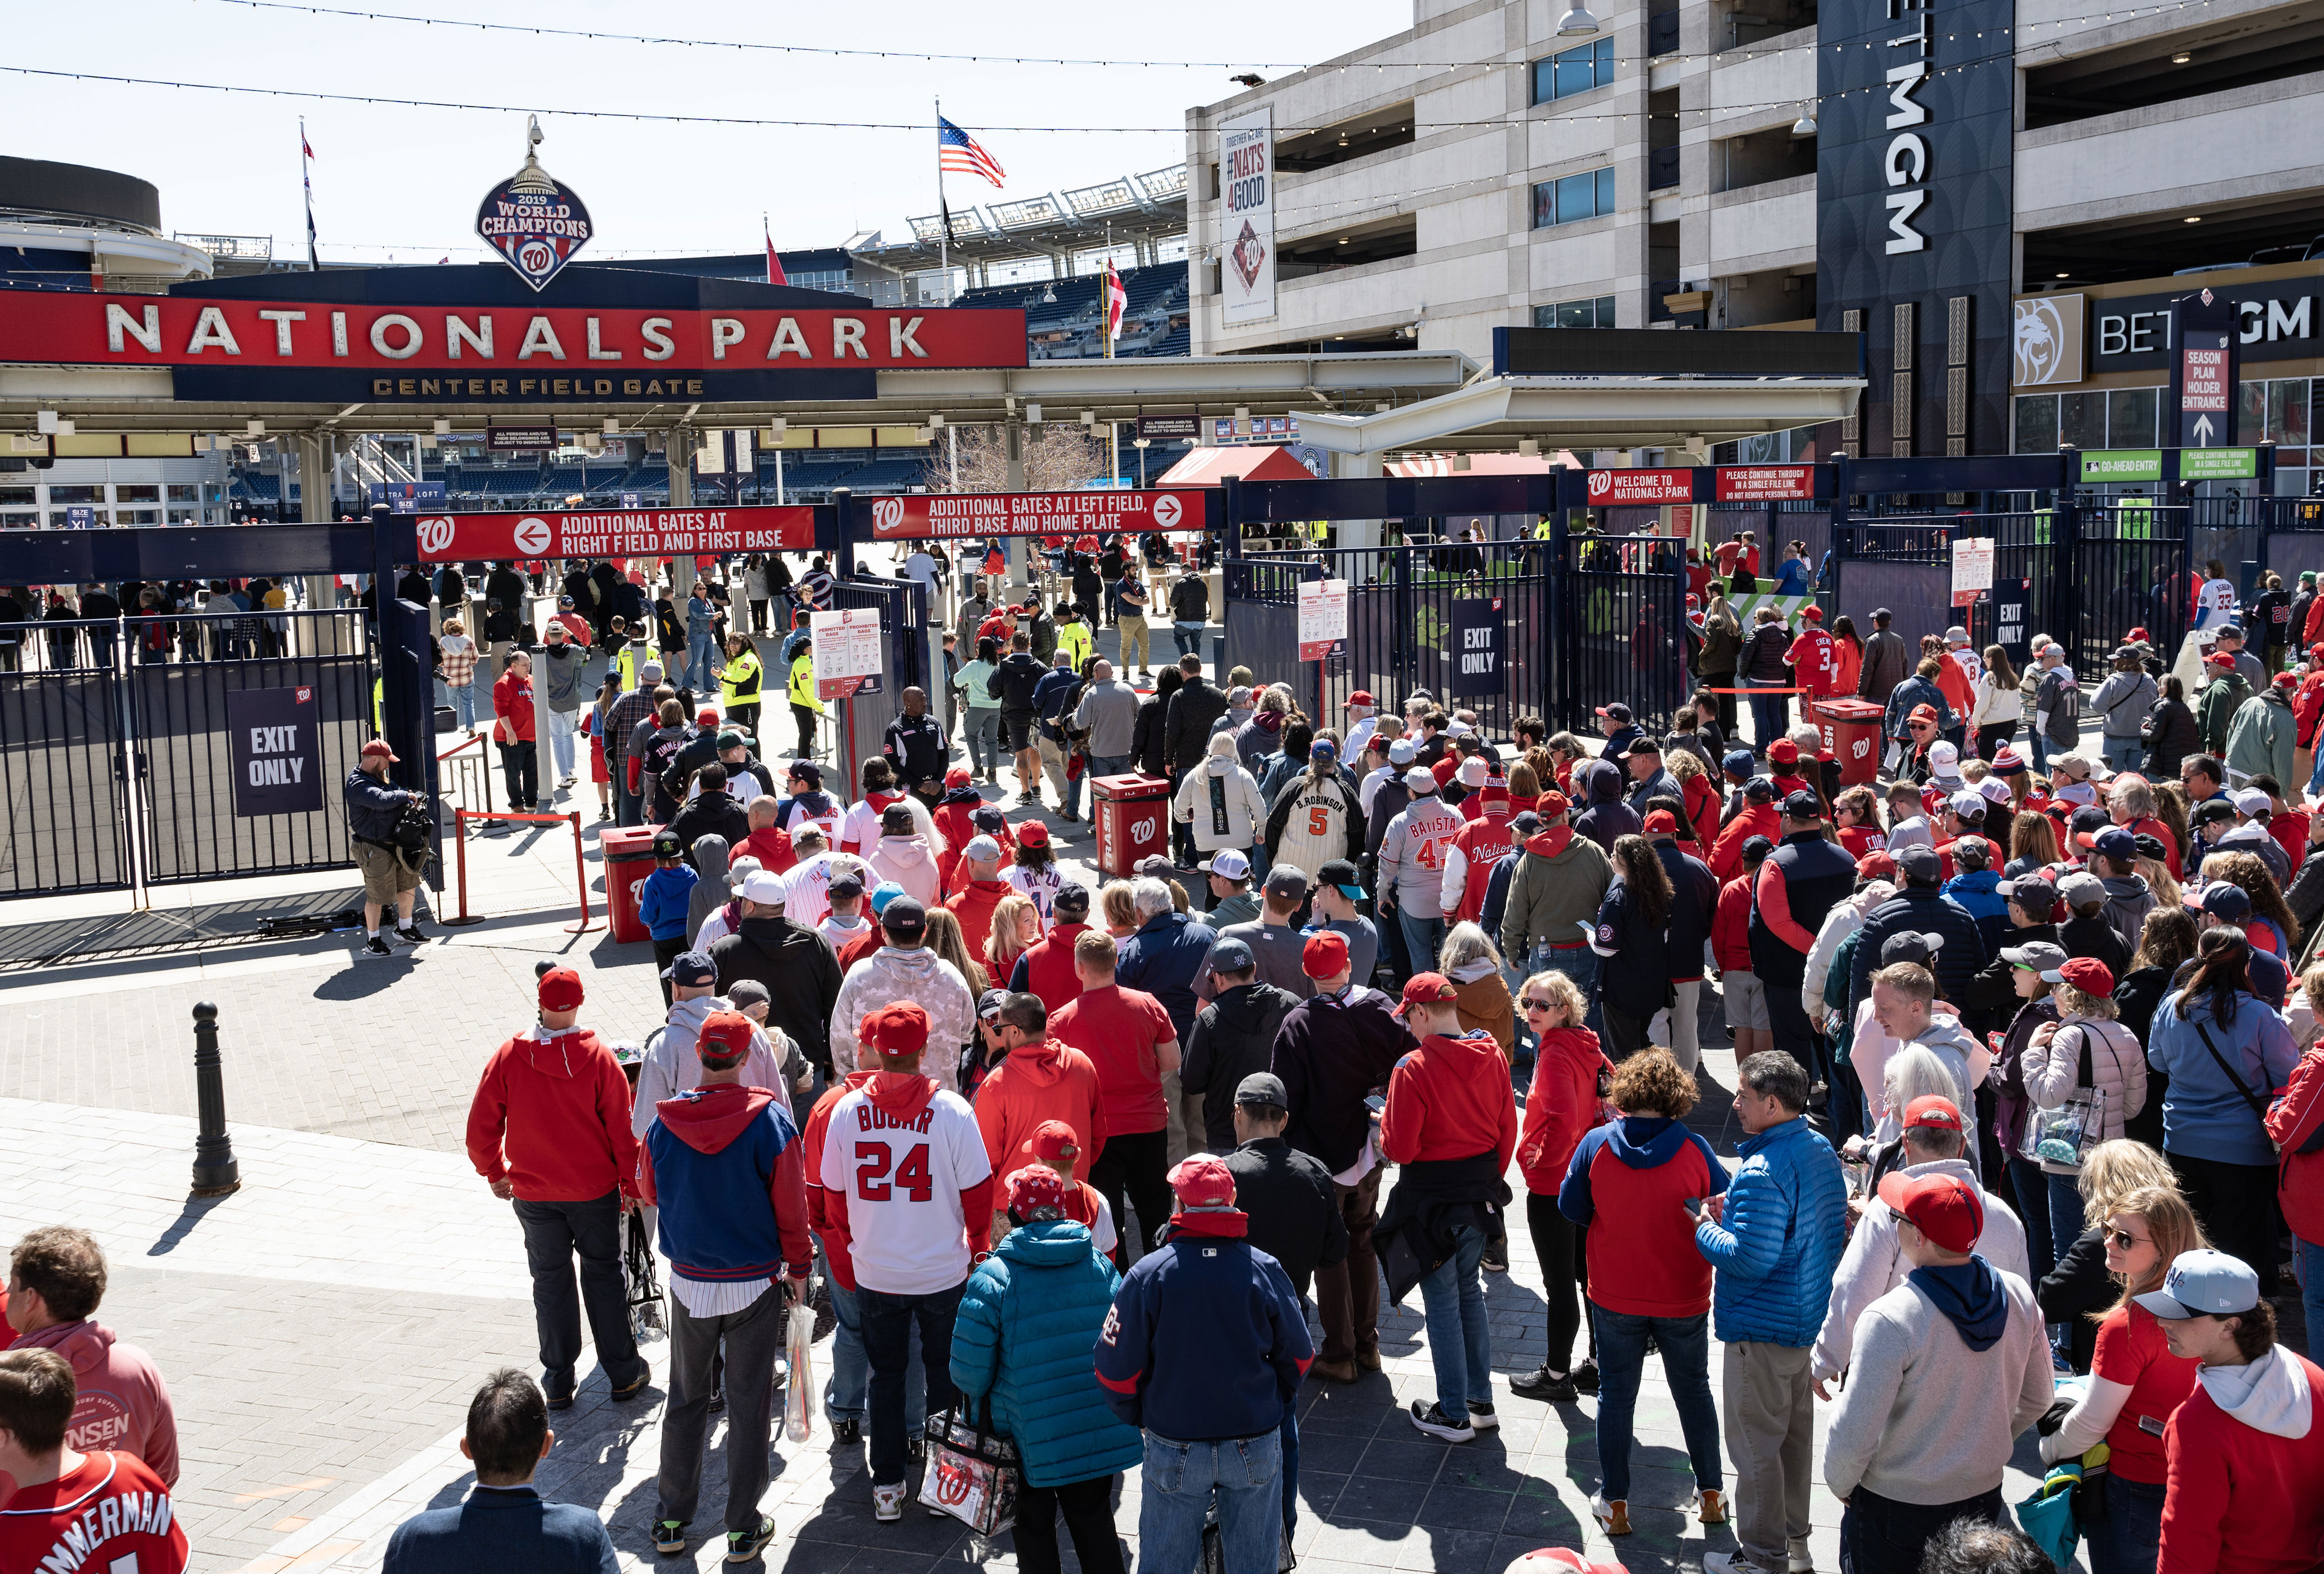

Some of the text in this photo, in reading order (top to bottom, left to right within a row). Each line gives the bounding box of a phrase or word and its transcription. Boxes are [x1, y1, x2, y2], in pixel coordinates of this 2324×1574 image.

[1226, 133, 1247, 148] TOGETHER
[1255, 127, 1264, 139] ARE
[1227, 143, 1264, 181] #NATS
[518, 195, 547, 205] 2019
[1227, 175, 1265, 213] 4GOOD
[497, 201, 570, 218] WORLD
[482, 217, 588, 238] CHAMPIONS
[1229, 256, 1251, 297] PHILANTHROPIES
[105, 304, 930, 361] NATIONALS PARK
[2100, 296, 2311, 354] BETGM
[2188, 351, 2221, 364] SEASON
[2193, 367, 2215, 379] PLAN
[374, 379, 703, 395] CENTER FIELD GATE
[2187, 382, 2220, 394] HOLDER
[2182, 396, 2225, 409] ENTRANCE
[1726, 470, 1804, 480] PLEASE CONTINUE THROUGH
[2101, 460, 2158, 472] GO-AHEAD ENTRY
[1614, 475, 1672, 487] WELCOME TO
[1735, 481, 1741, 490] IN
[1748, 480, 1768, 489] SINGLE
[1769, 480, 1782, 488] FILE
[1614, 486, 1689, 499] NATIONALS PARK
[929, 495, 1147, 517] ADDITIONAL GATES AT LEFT FIELD,
[560, 512, 727, 535] ADDITIONAL GATES AT
[929, 514, 1122, 535] THIRD BASE AND HOME PLATE
[561, 530, 783, 554] RIGHT FIELD AND FIRST BASE
[2218, 593, 2232, 610] 33
[2000, 603, 2022, 622] EXIT
[1464, 627, 1492, 649] EXIT
[1816, 637, 1831, 646] CREWS
[1998, 625, 2024, 644] ONLY
[1462, 652, 1495, 674] ONLY
[1819, 647, 1831, 671] 3
[1969, 665, 1976, 681] 8
[2063, 691, 2077, 717] 11
[250, 725, 297, 754] EXIT
[248, 757, 304, 786] ONLY
[1295, 795, 1345, 813] B.ROBINSON
[1216, 808, 1225, 830] MESSI
[1309, 806, 1328, 836] 5
[1103, 805, 1113, 869] TRASH
[1234, 955, 1245, 966] W
[993, 991, 1006, 1004] W
[855, 1141, 932, 1203] 24
[76, 1397, 120, 1414] SURF SUPPLY
[937, 1466, 973, 1506] W
